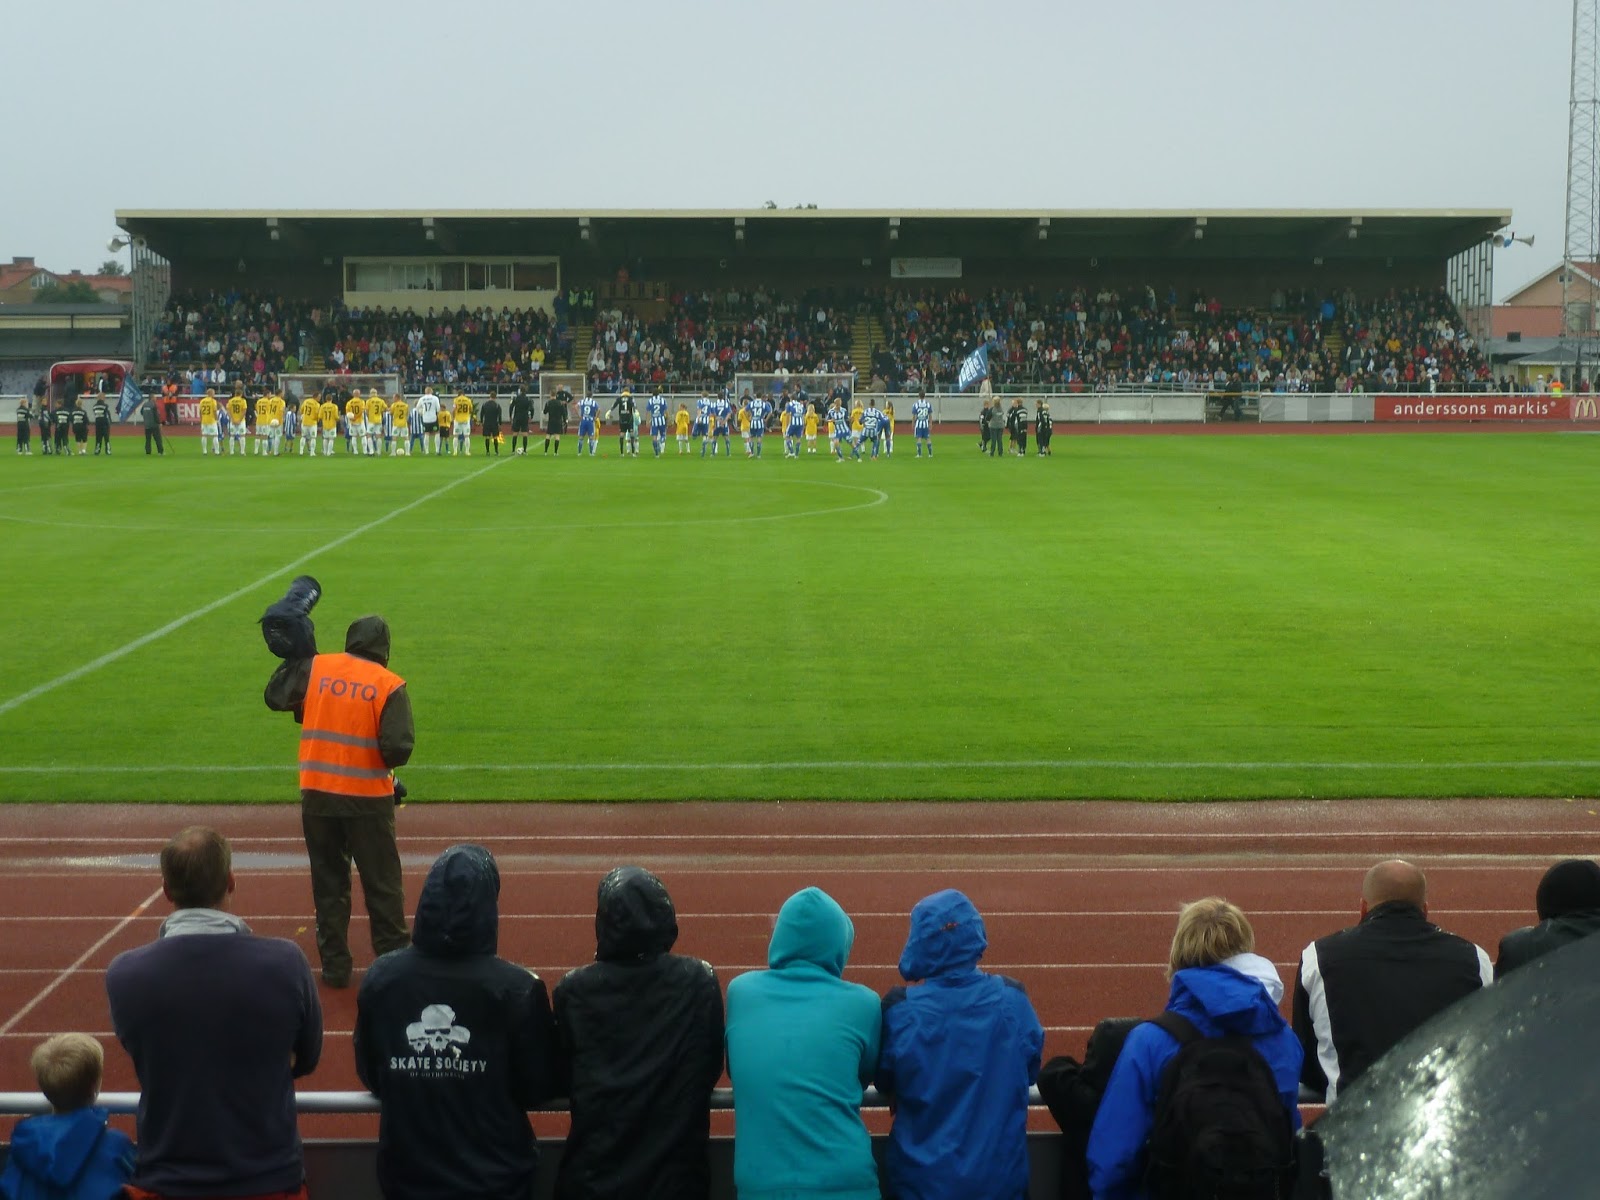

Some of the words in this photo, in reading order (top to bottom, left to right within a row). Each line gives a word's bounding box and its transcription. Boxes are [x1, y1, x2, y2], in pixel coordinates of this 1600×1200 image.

[202, 405, 211, 415] 23
[259, 405, 266, 415] 15
[270, 404, 277, 414] 14
[351, 405, 360, 414] 10
[374, 405, 380, 415] 3
[423, 402, 432, 412] 17
[457, 403, 468, 413] 28
[584, 405, 591, 415] 9
[622, 401, 628, 411] 1
[653, 404, 661, 414] 2
[702, 405, 709, 414] 4
[1394, 401, 1487, 415] anderssons
[1574, 399, 1598, 419] M
[399, 409, 404, 420] 2
[717, 407, 724, 416] 7
[752, 407, 763, 416] 14
[917, 407, 929, 418] 28
[864, 416, 878, 426] 22
[319, 677, 378, 702] FOTO
[390, 1056, 431, 1070] SKATE
[435, 1056, 487, 1073] SOCIETY
